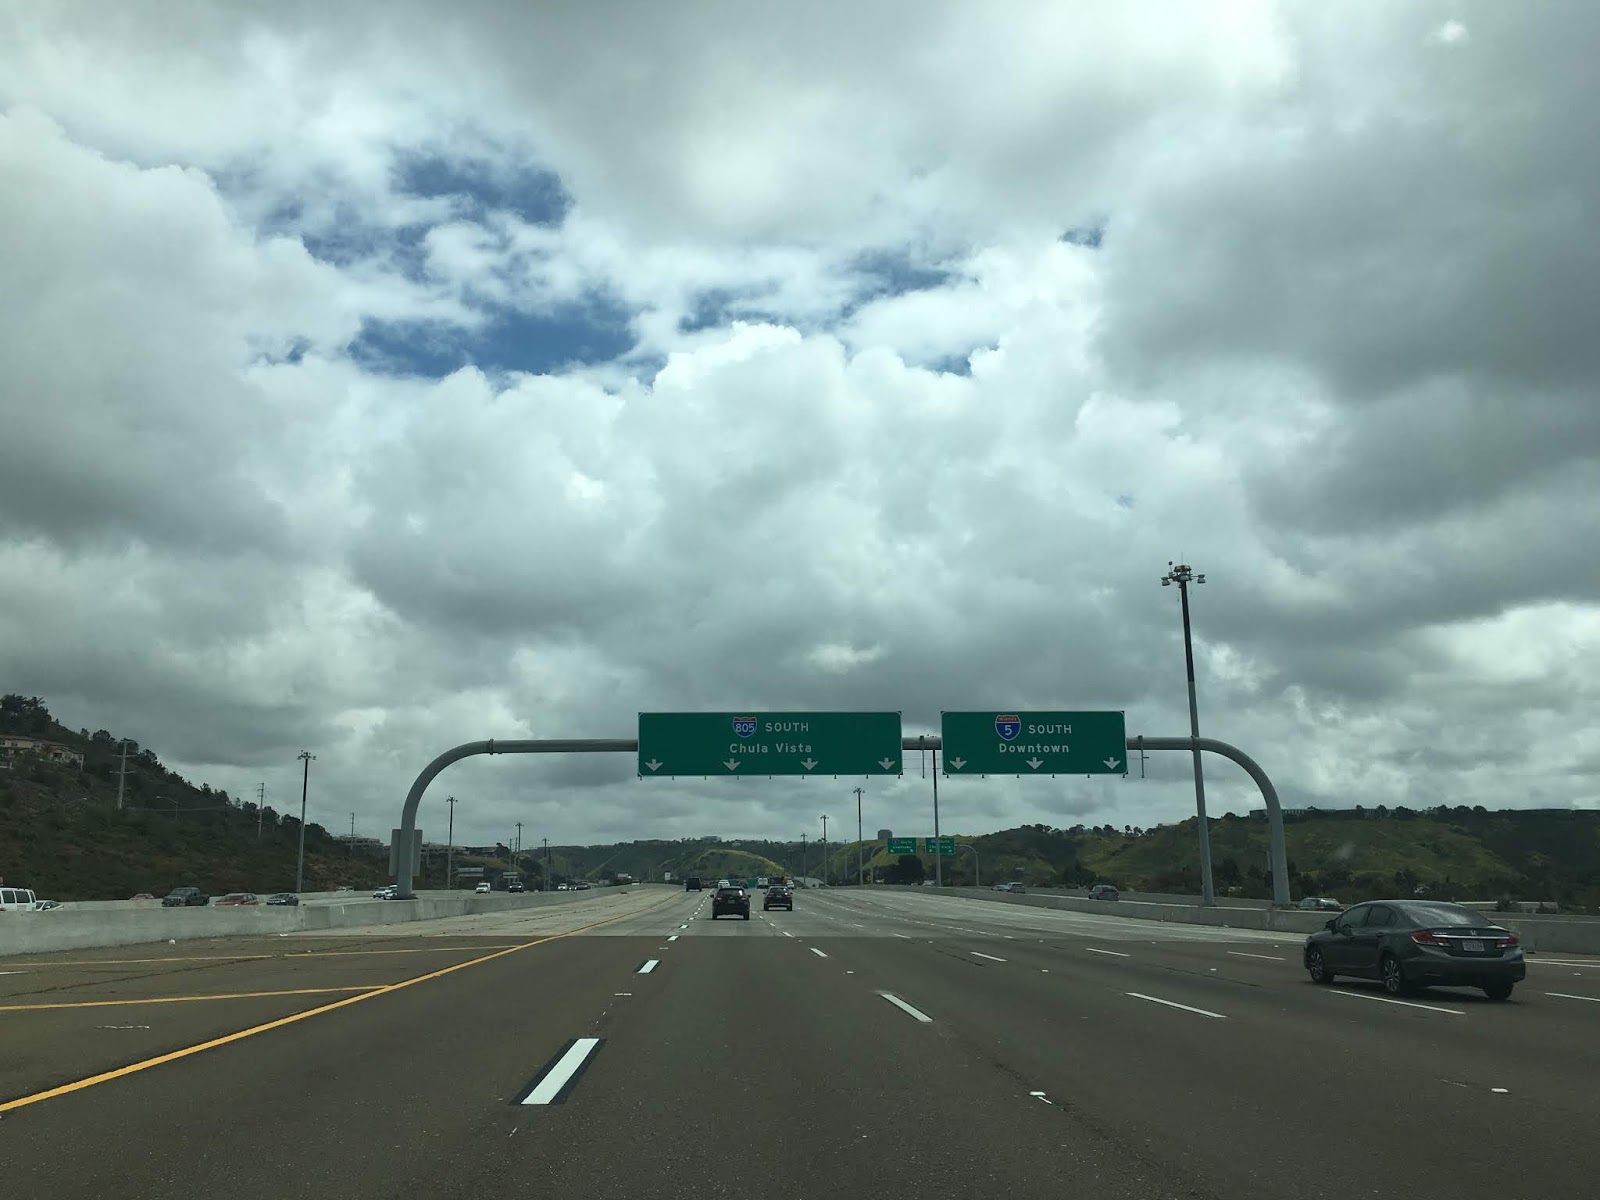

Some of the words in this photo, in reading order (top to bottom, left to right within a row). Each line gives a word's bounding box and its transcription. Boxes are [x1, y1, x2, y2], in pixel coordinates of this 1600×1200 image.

[735, 723, 755, 733] 805
[765, 722, 809, 732] SOUTH
[1004, 724, 1013, 736] 5
[1028, 724, 1072, 734] SOUTH
[729, 743, 768, 753] Chula
[775, 743, 812, 753] Vista
[999, 743, 1070, 753] Downtown
